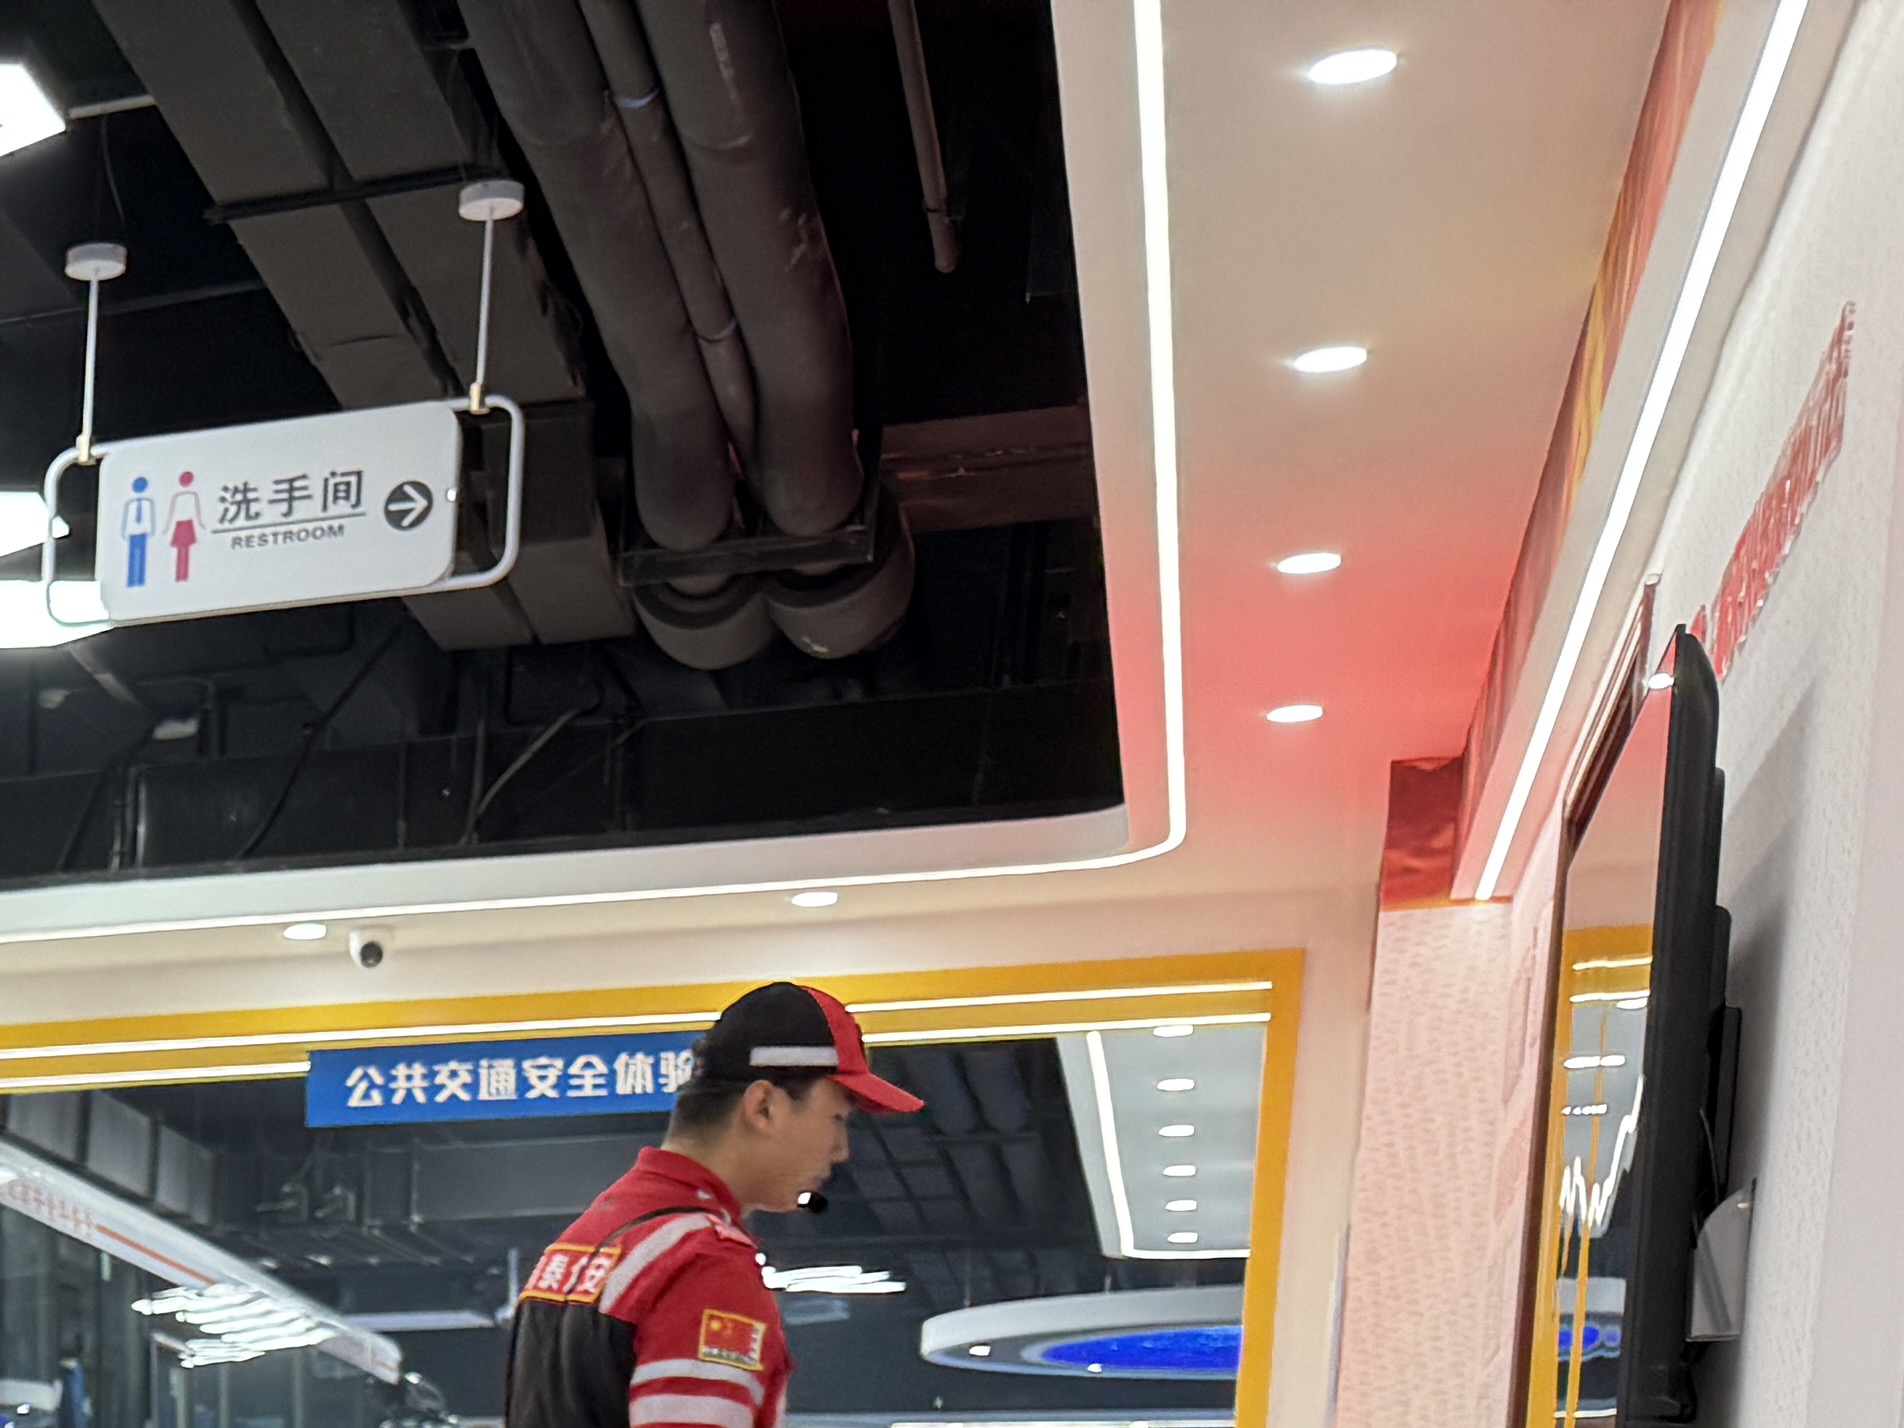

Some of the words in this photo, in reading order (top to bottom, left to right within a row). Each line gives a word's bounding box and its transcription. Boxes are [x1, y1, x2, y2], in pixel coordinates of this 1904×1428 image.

[218, 470, 363, 524] 洗手间
[231, 524, 345, 550] RESTROOM
